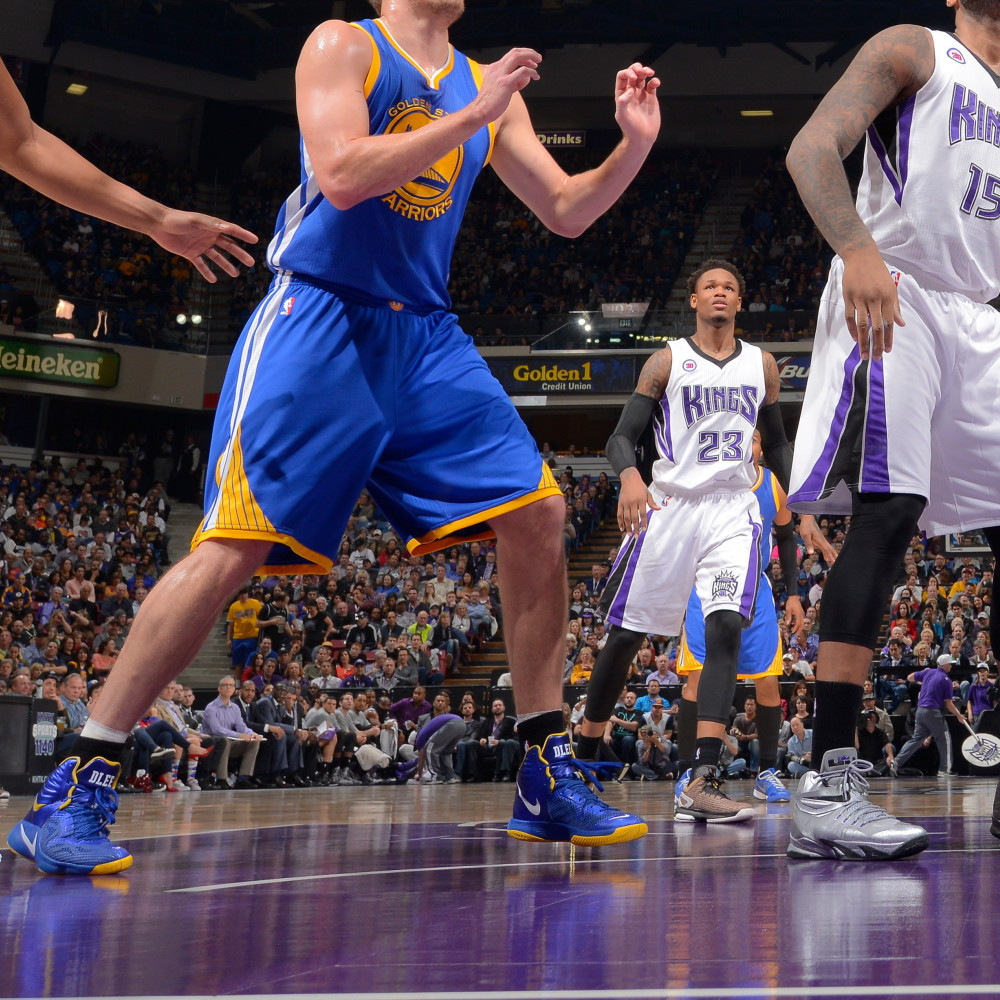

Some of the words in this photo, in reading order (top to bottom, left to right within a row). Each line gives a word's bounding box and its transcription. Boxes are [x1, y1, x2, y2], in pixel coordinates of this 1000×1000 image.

[388, 98, 432, 117] GOLDEN
[537, 134, 582, 144] Drinks
[382, 194, 453, 222] ARRIORS
[0, 346, 103, 380] eineken
[542, 383, 566, 391] Credit
[568, 383, 592, 391] Union
[681, 384, 758, 429] KINGS
[697, 430, 744, 462] 23
[32, 723, 57, 738] SPORTS
[34, 739, 55, 756] 1140
[89, 770, 116, 788] DLEE
